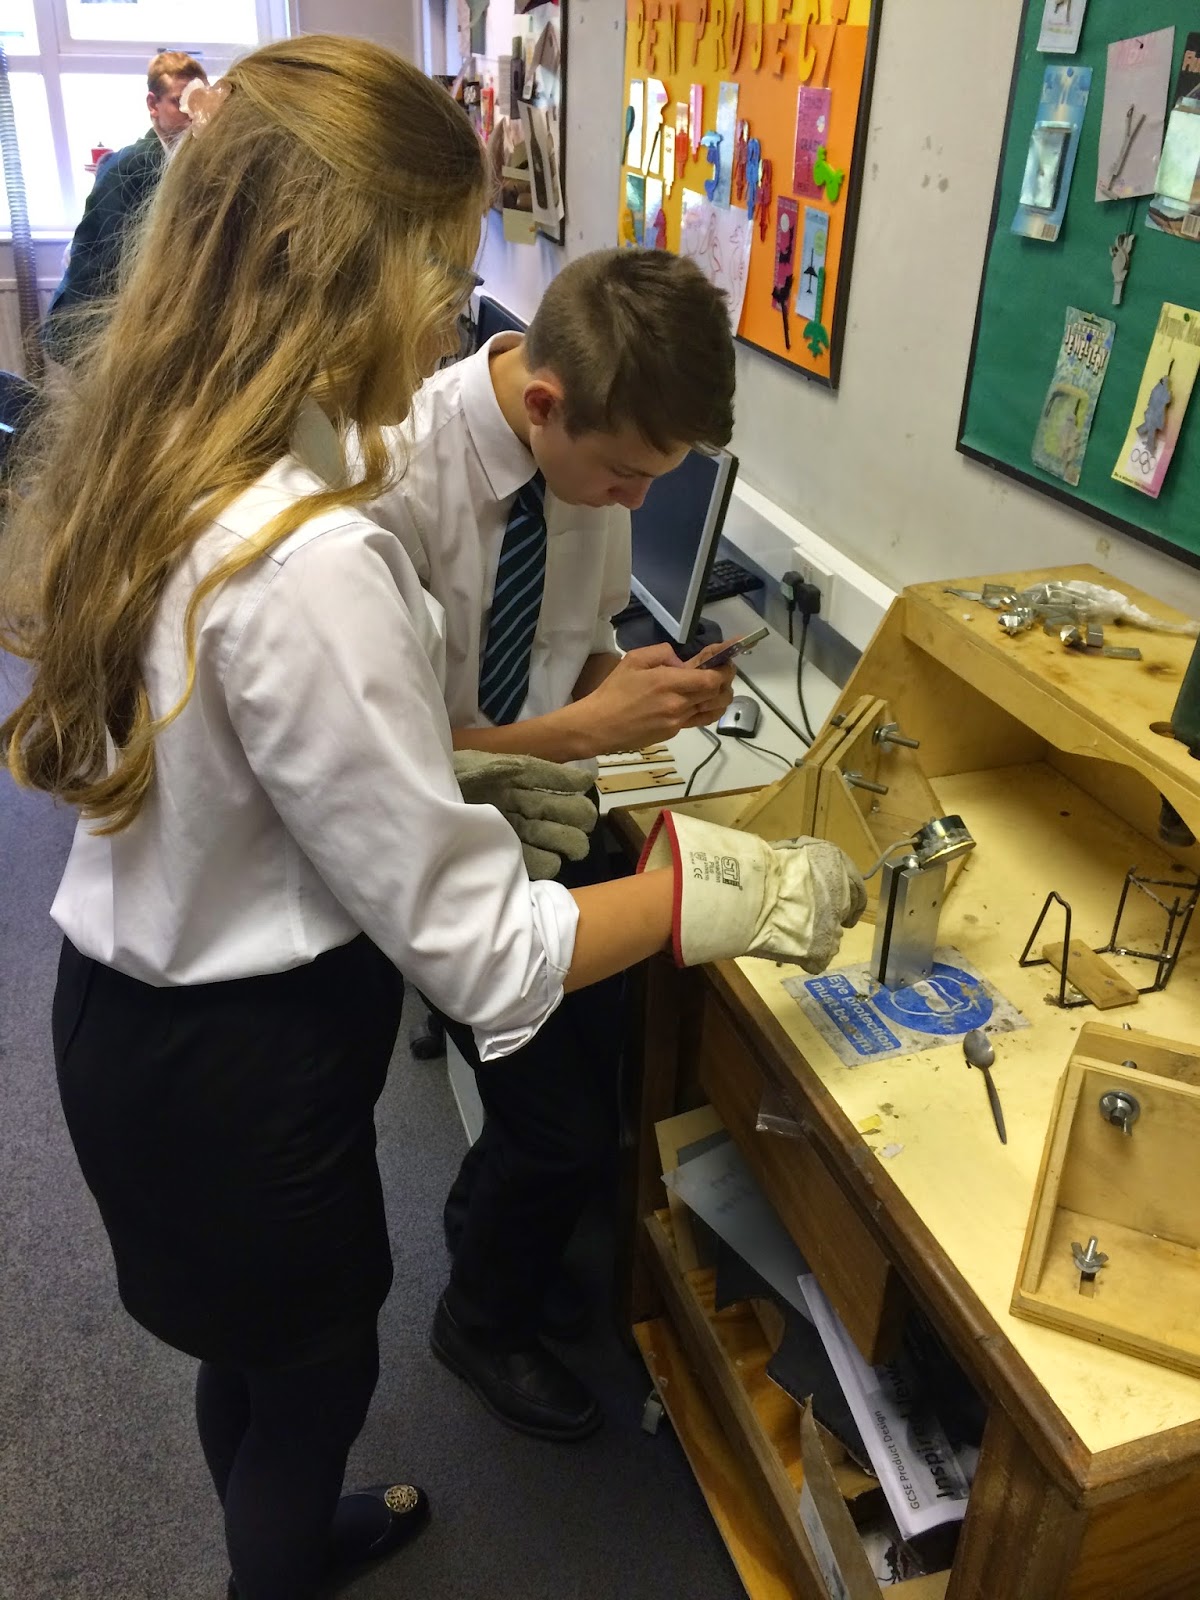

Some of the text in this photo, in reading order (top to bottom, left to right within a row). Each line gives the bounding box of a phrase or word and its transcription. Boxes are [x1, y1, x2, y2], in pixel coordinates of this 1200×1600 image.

[632, 0, 850, 88] PEN PROJECT
[811, 981, 840, 1009] must
[833, 1008, 850, 1023] be
[827, 976, 896, 1050] Eye protection
[874, 1410, 920, 1510] GCSE Product Design
